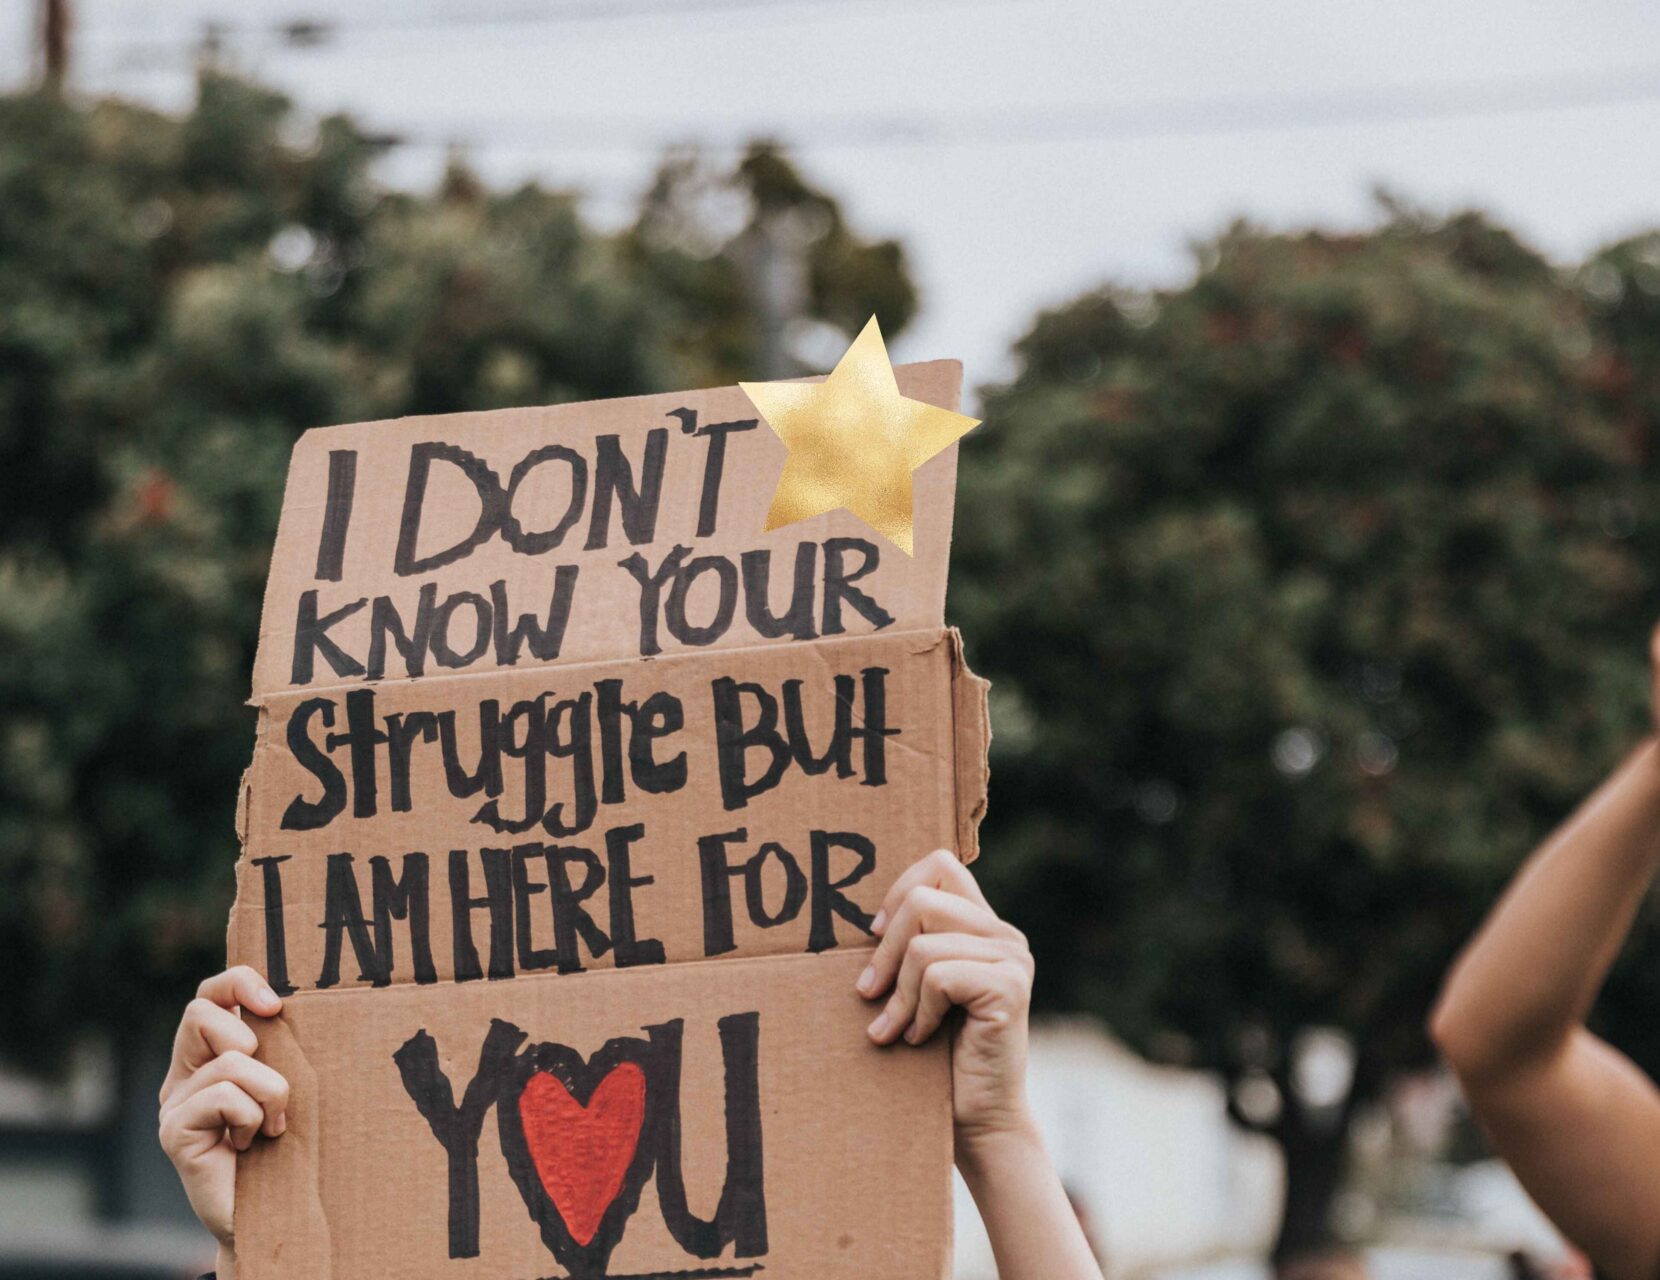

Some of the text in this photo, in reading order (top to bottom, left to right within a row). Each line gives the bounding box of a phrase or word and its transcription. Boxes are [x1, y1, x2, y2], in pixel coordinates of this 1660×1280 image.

[315, 407, 759, 582] I DON'T
[290, 537, 896, 685] KNOW YOUR
[279, 678, 689, 839] Struggle
[251, 822, 877, 997] I AM HERE FOR
